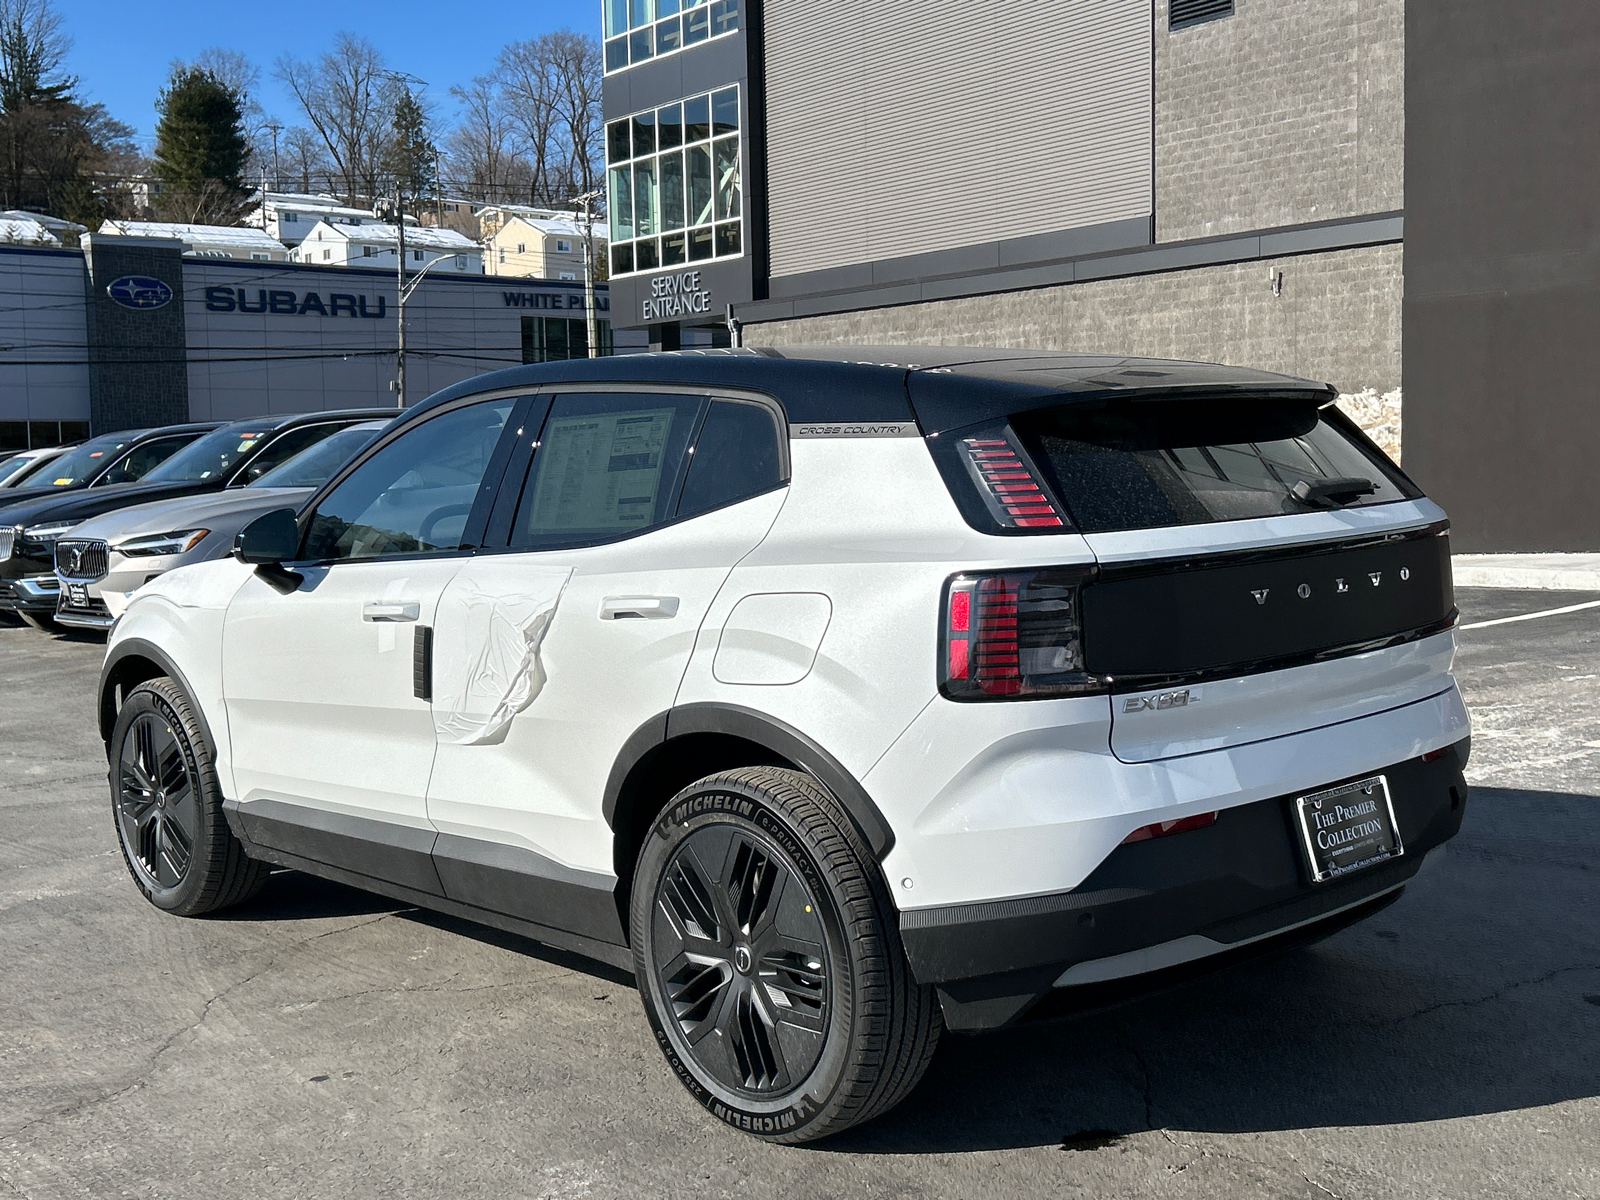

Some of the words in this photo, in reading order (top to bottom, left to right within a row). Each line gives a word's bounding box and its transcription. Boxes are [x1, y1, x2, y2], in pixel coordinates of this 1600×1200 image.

[651, 271, 700, 297] SERVICE
[205, 286, 386, 318] SUBARU
[503, 291, 563, 309] WHITE
[643, 291, 712, 320] ENTRANCE
[799, 427, 841, 435] CROSS
[843, 426, 906, 434] COUNTRY
[1251, 566, 1410, 605] VOLVO
[676, 795, 753, 821] MICHELIN
[1311, 811, 1337, 830] THE
[1334, 800, 1378, 823] PREMIER
[1317, 818, 1382, 850] COLLECTION
[713, 1103, 796, 1132] MICHELIN
